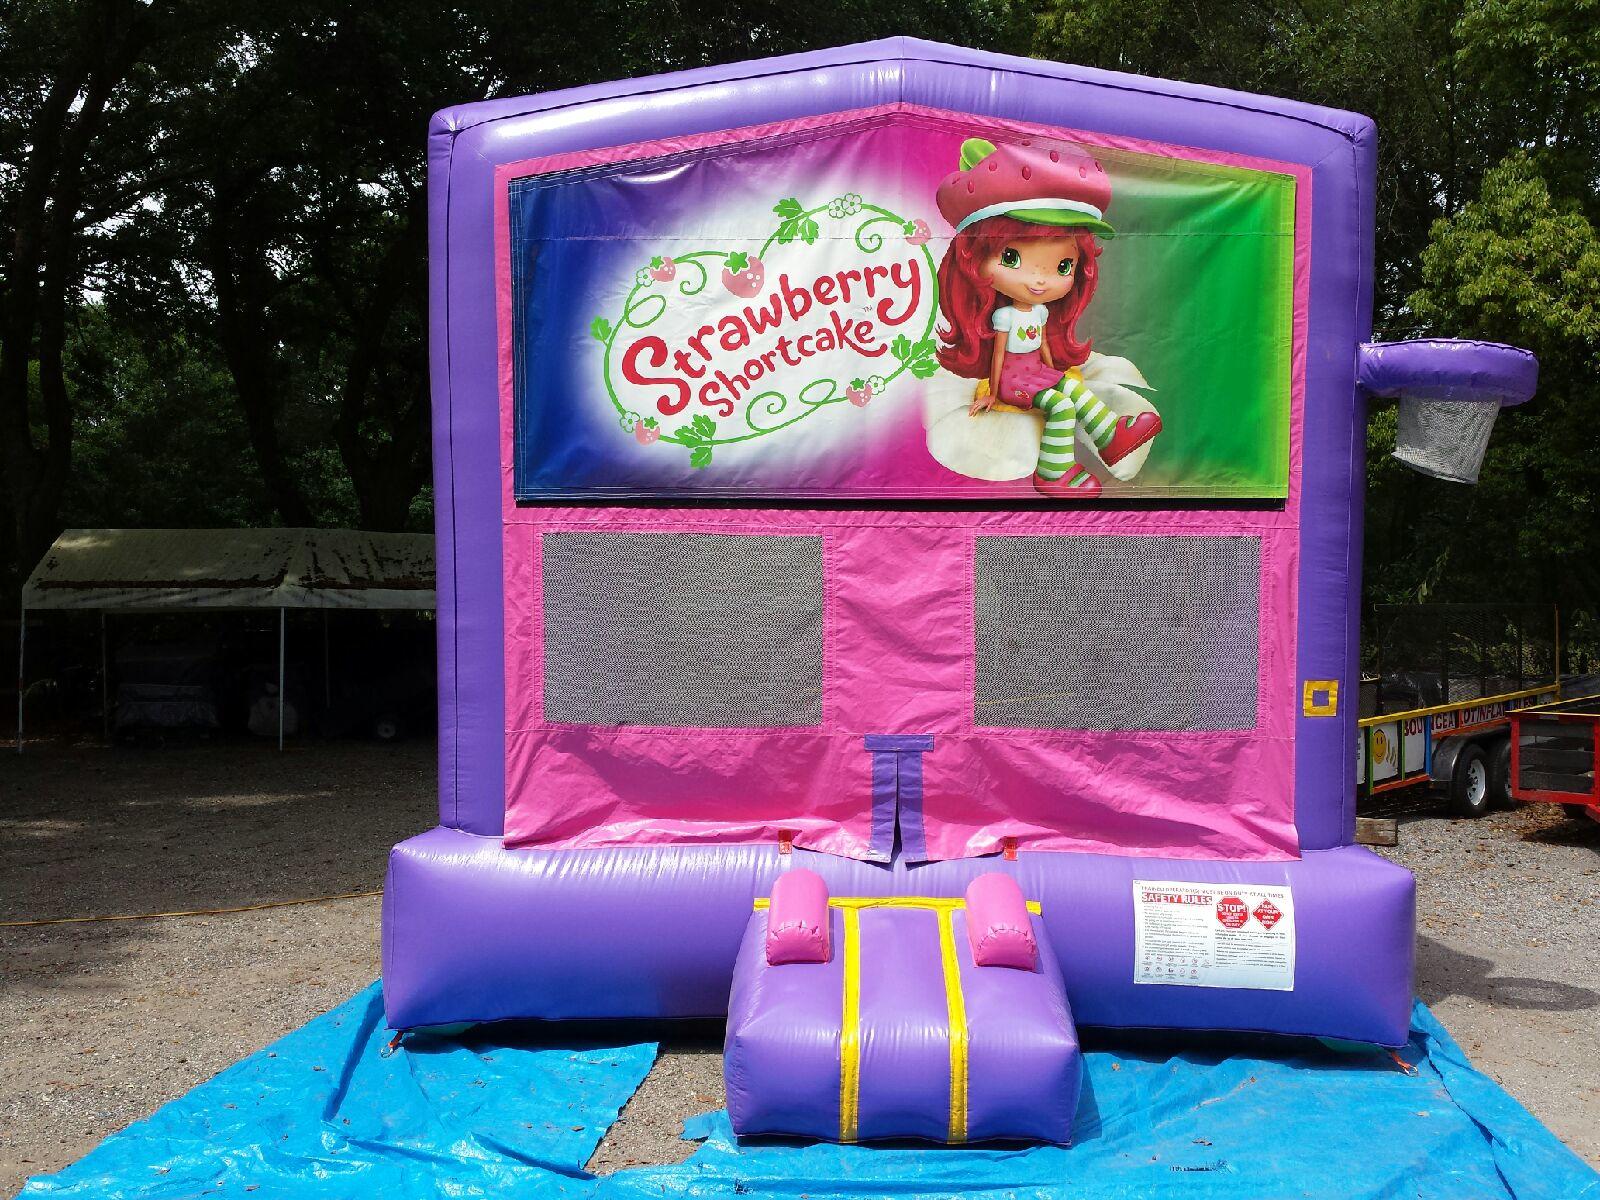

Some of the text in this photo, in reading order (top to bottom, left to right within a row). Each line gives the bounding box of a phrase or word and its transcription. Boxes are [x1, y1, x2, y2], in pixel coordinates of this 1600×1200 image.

[622, 258, 921, 416] Strawberry
[699, 311, 888, 417] Shortcake
[1142, 892, 1213, 905] SAFETY RULES
[1217, 903, 1247, 913] STOP!
